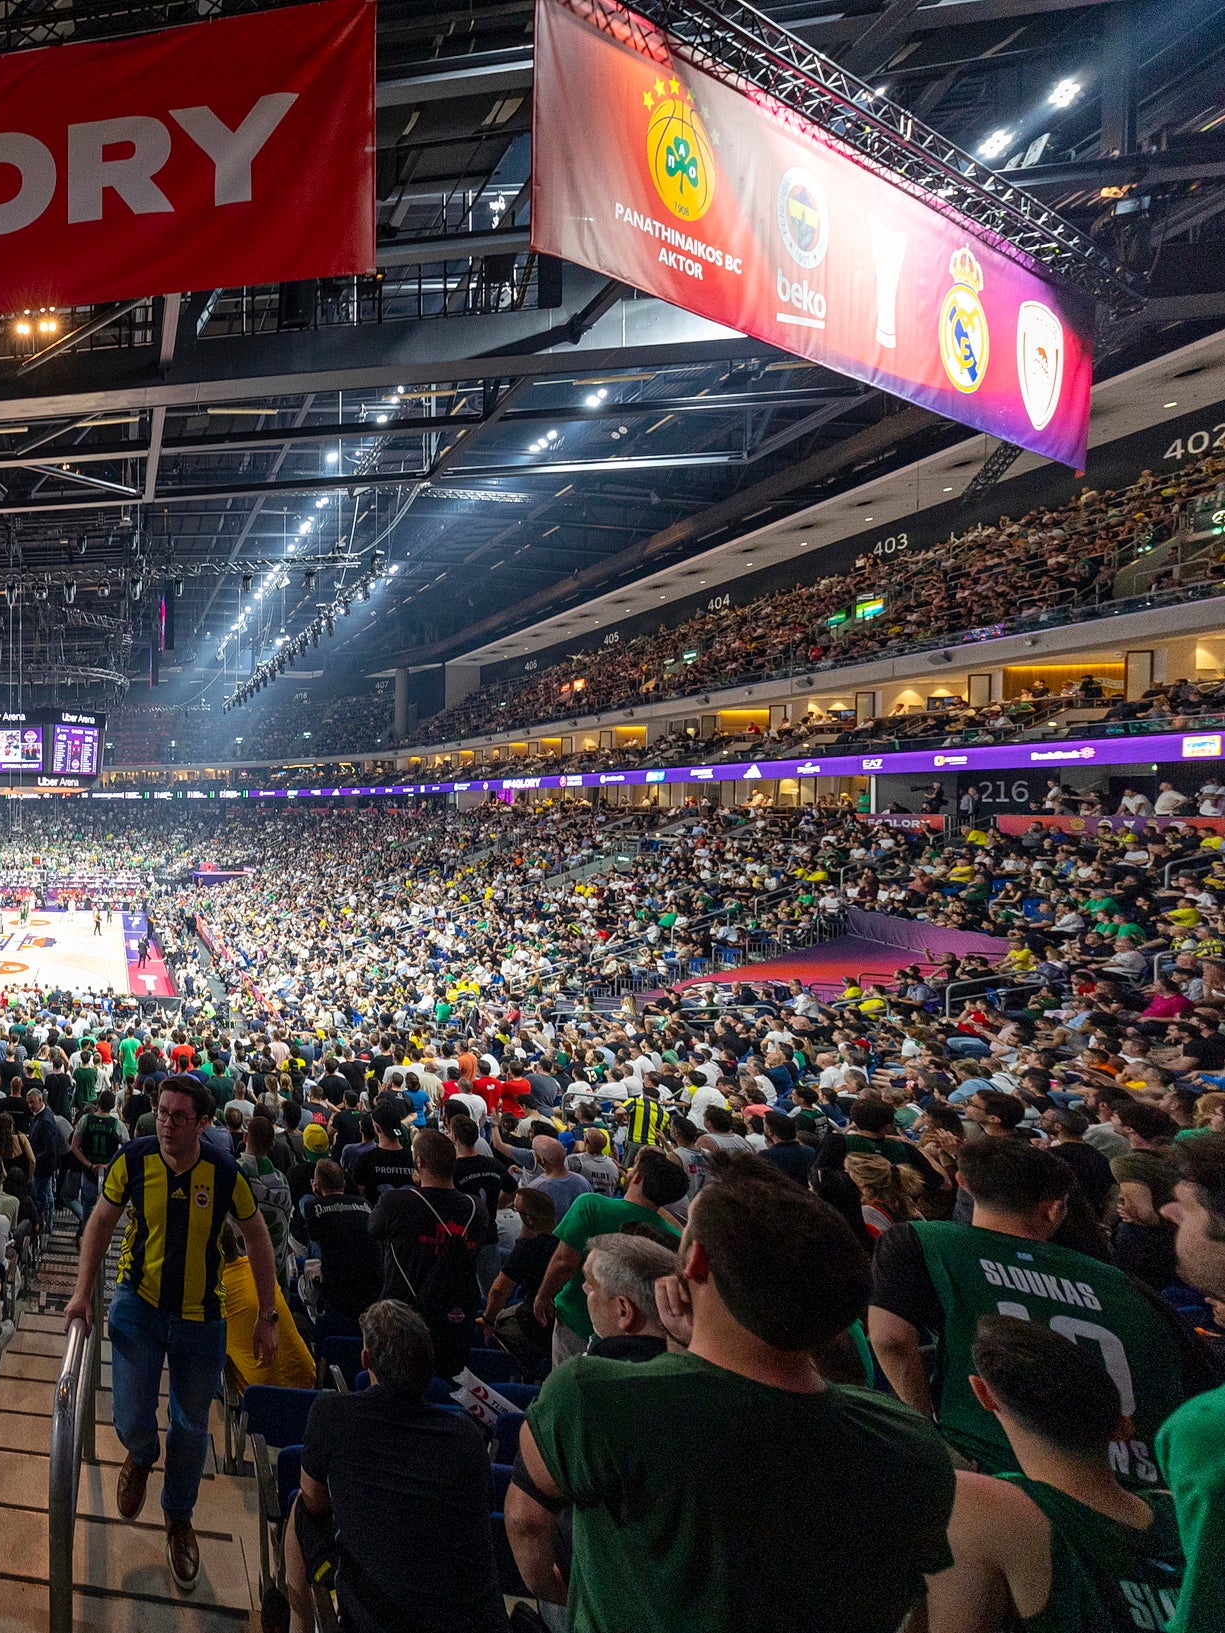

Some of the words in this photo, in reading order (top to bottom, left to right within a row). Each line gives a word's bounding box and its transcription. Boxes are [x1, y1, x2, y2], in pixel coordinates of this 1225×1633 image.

[615, 202, 723, 267] PANATHINAIKOS
[725, 254, 742, 275] BC
[658, 247, 703, 281] AKTOR
[777, 267, 827, 319] beko
[1163, 422, 1225, 460] 402
[873, 532, 908, 556] 403
[707, 593, 730, 612] 404
[603, 631, 619, 645] 405
[3, 713, 26, 721] Arena
[62, 712, 77, 722] Uber
[78, 714, 95, 724] Arena
[862, 758, 883, 767] EA7
[38, 776, 59, 787] Uber
[60, 777, 80, 787] Arena
[979, 780, 1029, 803] 216
[979, 1258, 1103, 1311] SLOUKAS
